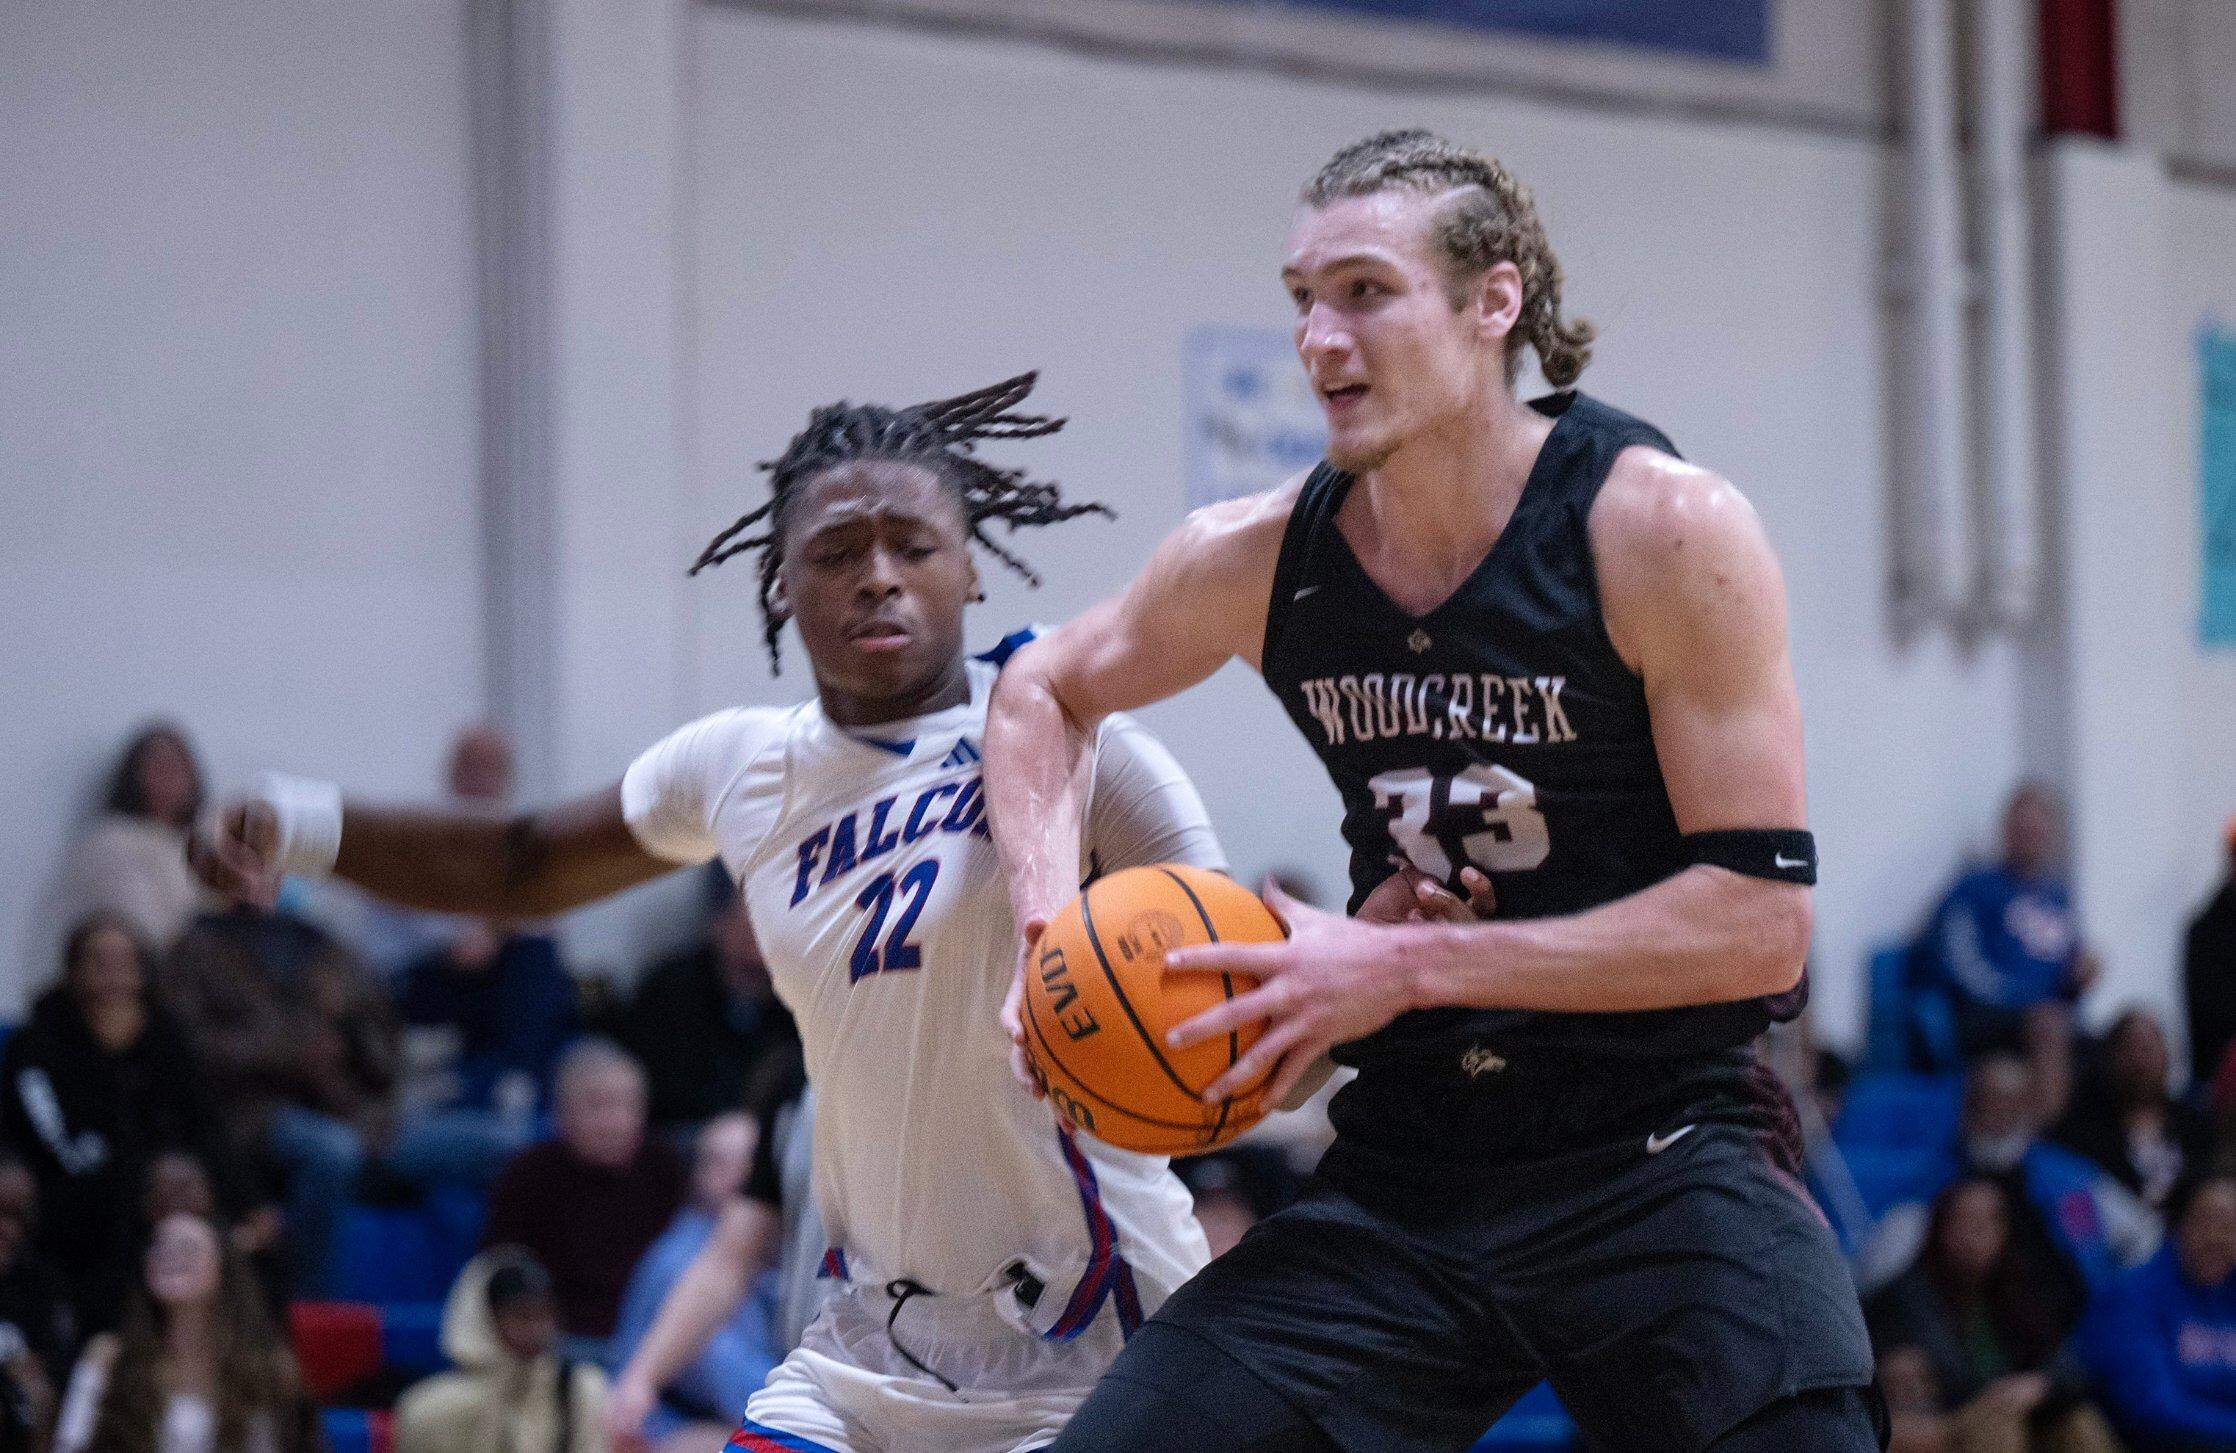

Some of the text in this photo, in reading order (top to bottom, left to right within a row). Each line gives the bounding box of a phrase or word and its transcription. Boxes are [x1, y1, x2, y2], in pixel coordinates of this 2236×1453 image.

[1301, 672, 1578, 746] WOODCREEK
[789, 775, 993, 909] FALCO
[850, 857, 942, 984] 22
